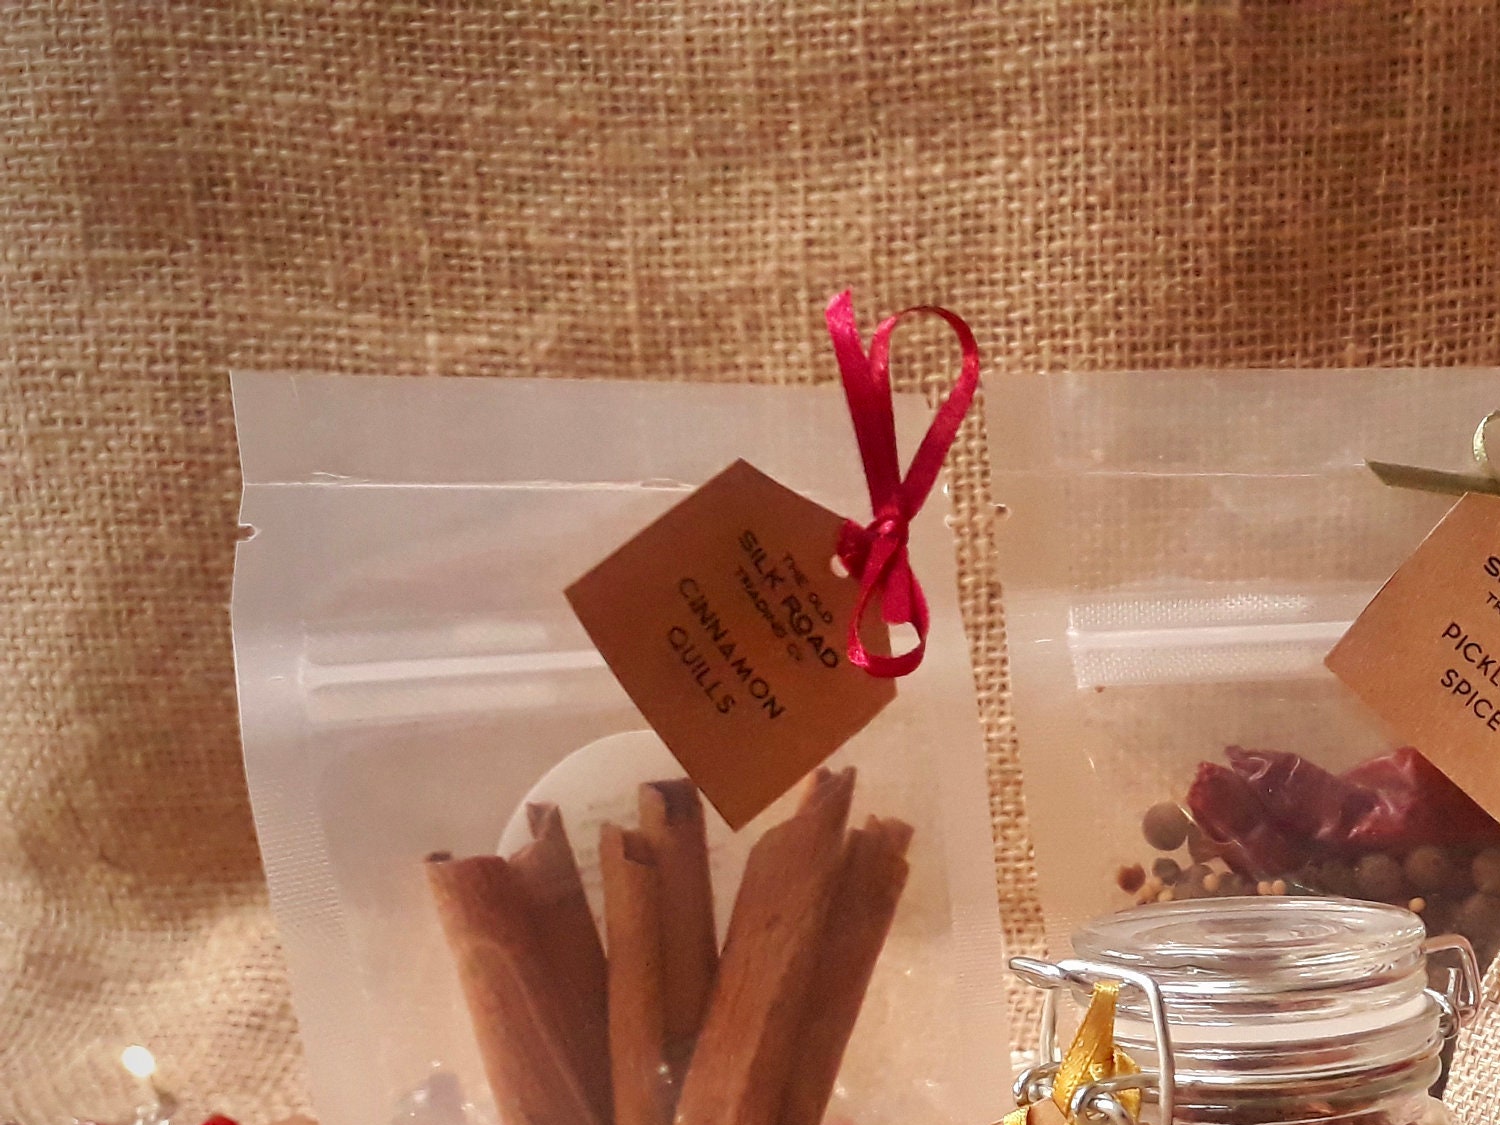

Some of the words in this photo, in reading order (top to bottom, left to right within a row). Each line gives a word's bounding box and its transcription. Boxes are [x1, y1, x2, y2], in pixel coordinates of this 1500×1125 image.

[679, 577, 786, 719] CINNAMON
[738, 530, 784, 589] SILK
[783, 595, 839, 668] ROAD
[668, 626, 735, 714] QUILLS
